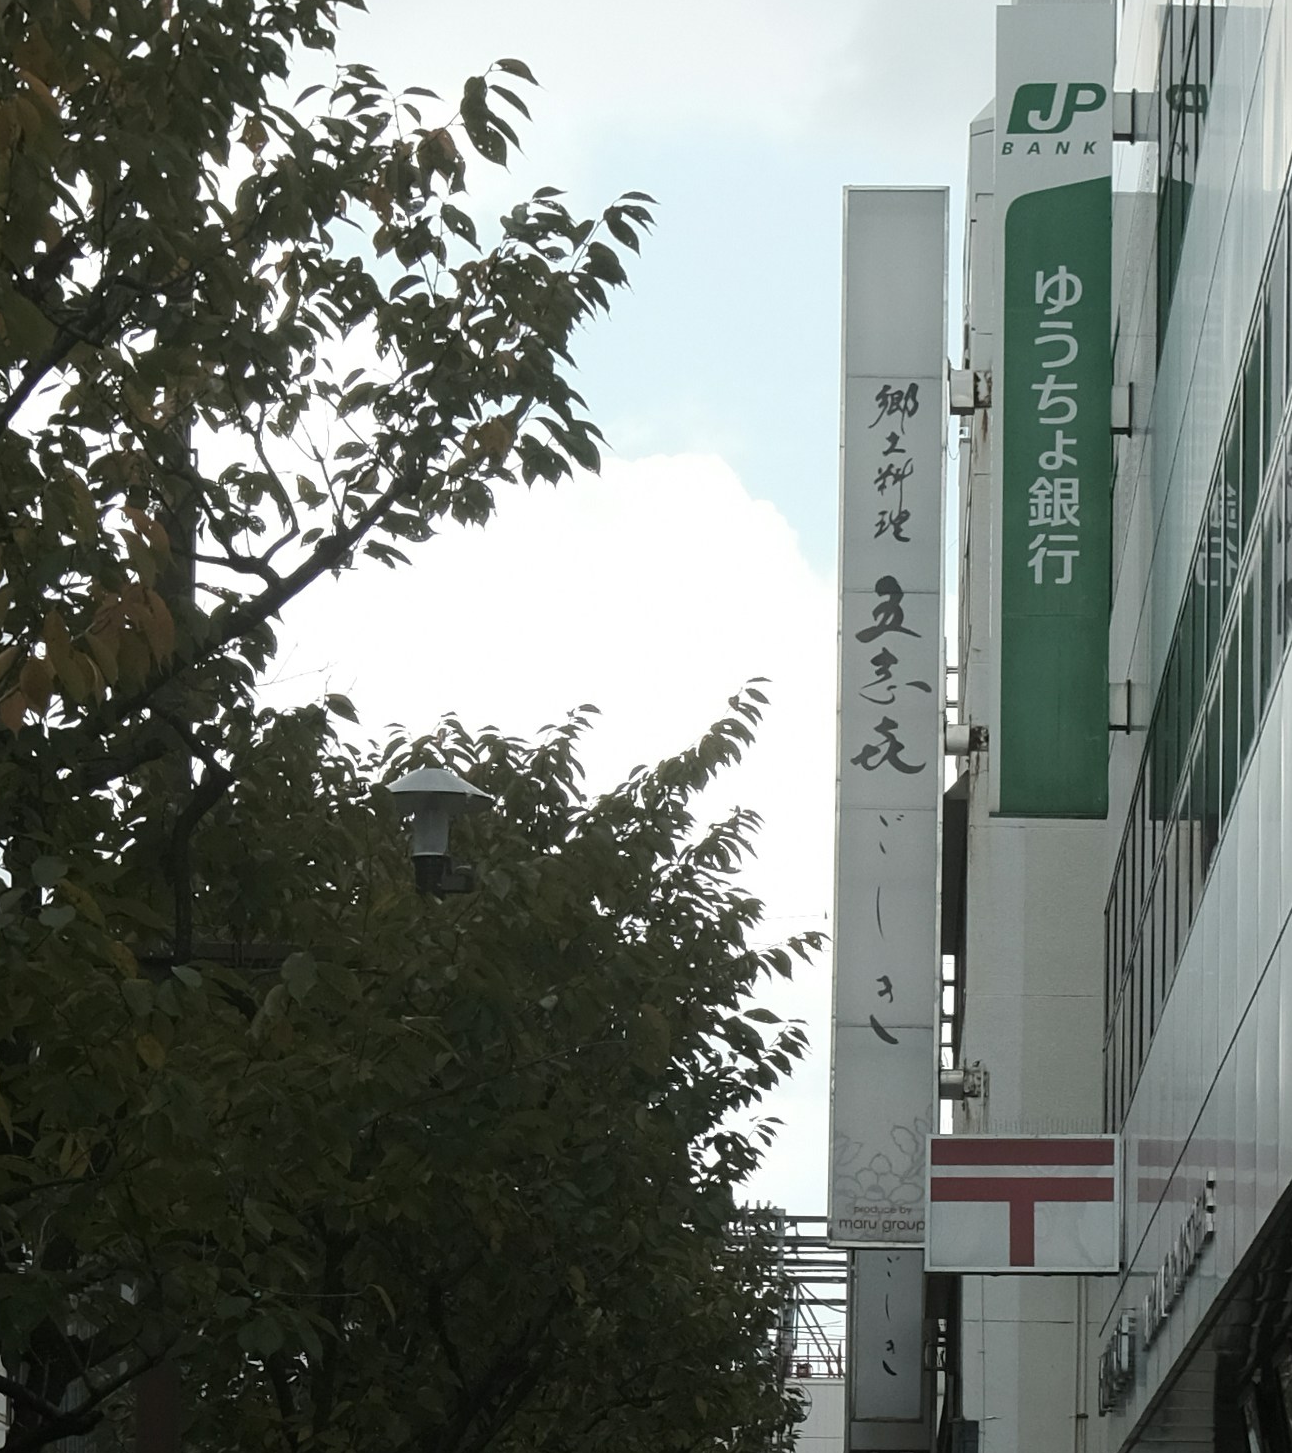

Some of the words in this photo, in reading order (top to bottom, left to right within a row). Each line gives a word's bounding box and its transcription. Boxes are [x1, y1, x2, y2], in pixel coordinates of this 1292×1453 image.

[1006, 82, 1106, 134] JP
[1001, 142, 1098, 155] BANK
[1027, 265, 1083, 586] ゆうちょ銀行
[839, 1219, 877, 1230] maru
[882, 1220, 925, 1233] group
